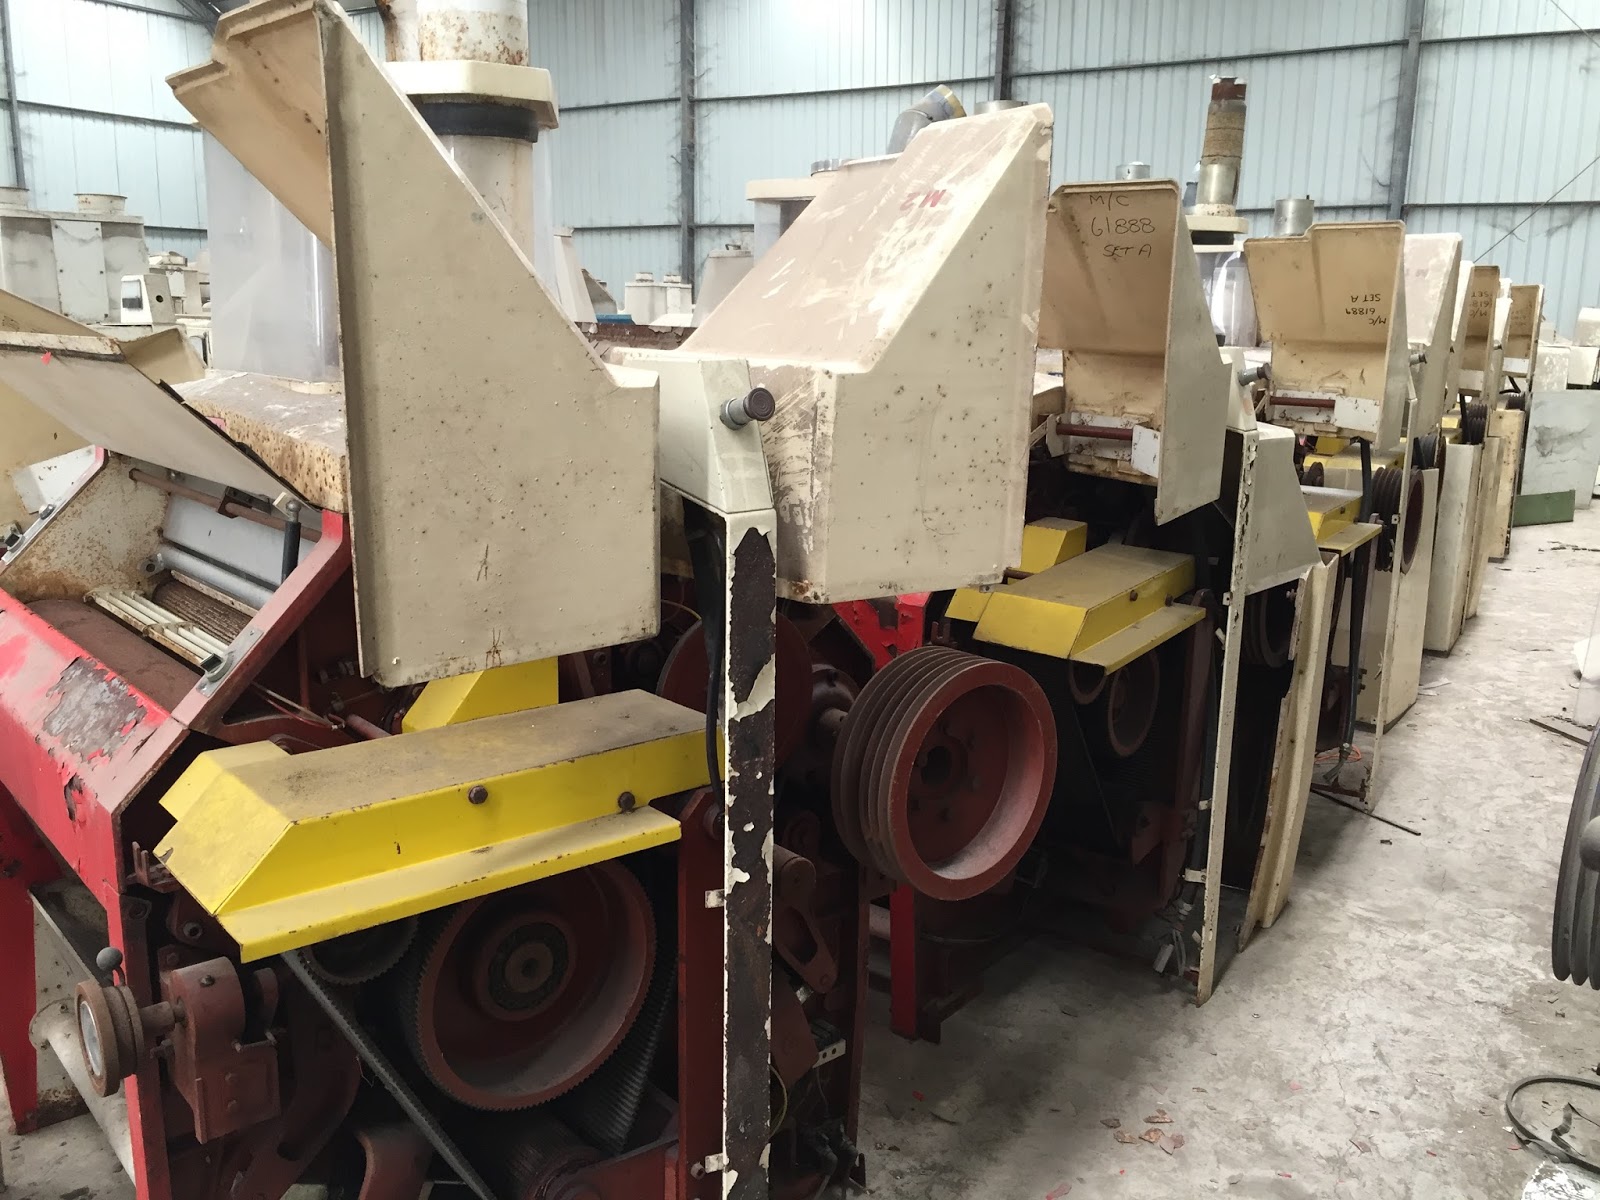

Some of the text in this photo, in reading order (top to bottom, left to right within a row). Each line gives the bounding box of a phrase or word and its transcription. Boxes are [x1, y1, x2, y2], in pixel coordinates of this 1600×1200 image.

[1089, 192, 1130, 211] M/C
[1091, 217, 1155, 237] 61888
[1103, 243, 1152, 258] SET A
[1350, 293, 1381, 303] SET A
[1368, 315, 1387, 326] M/C
